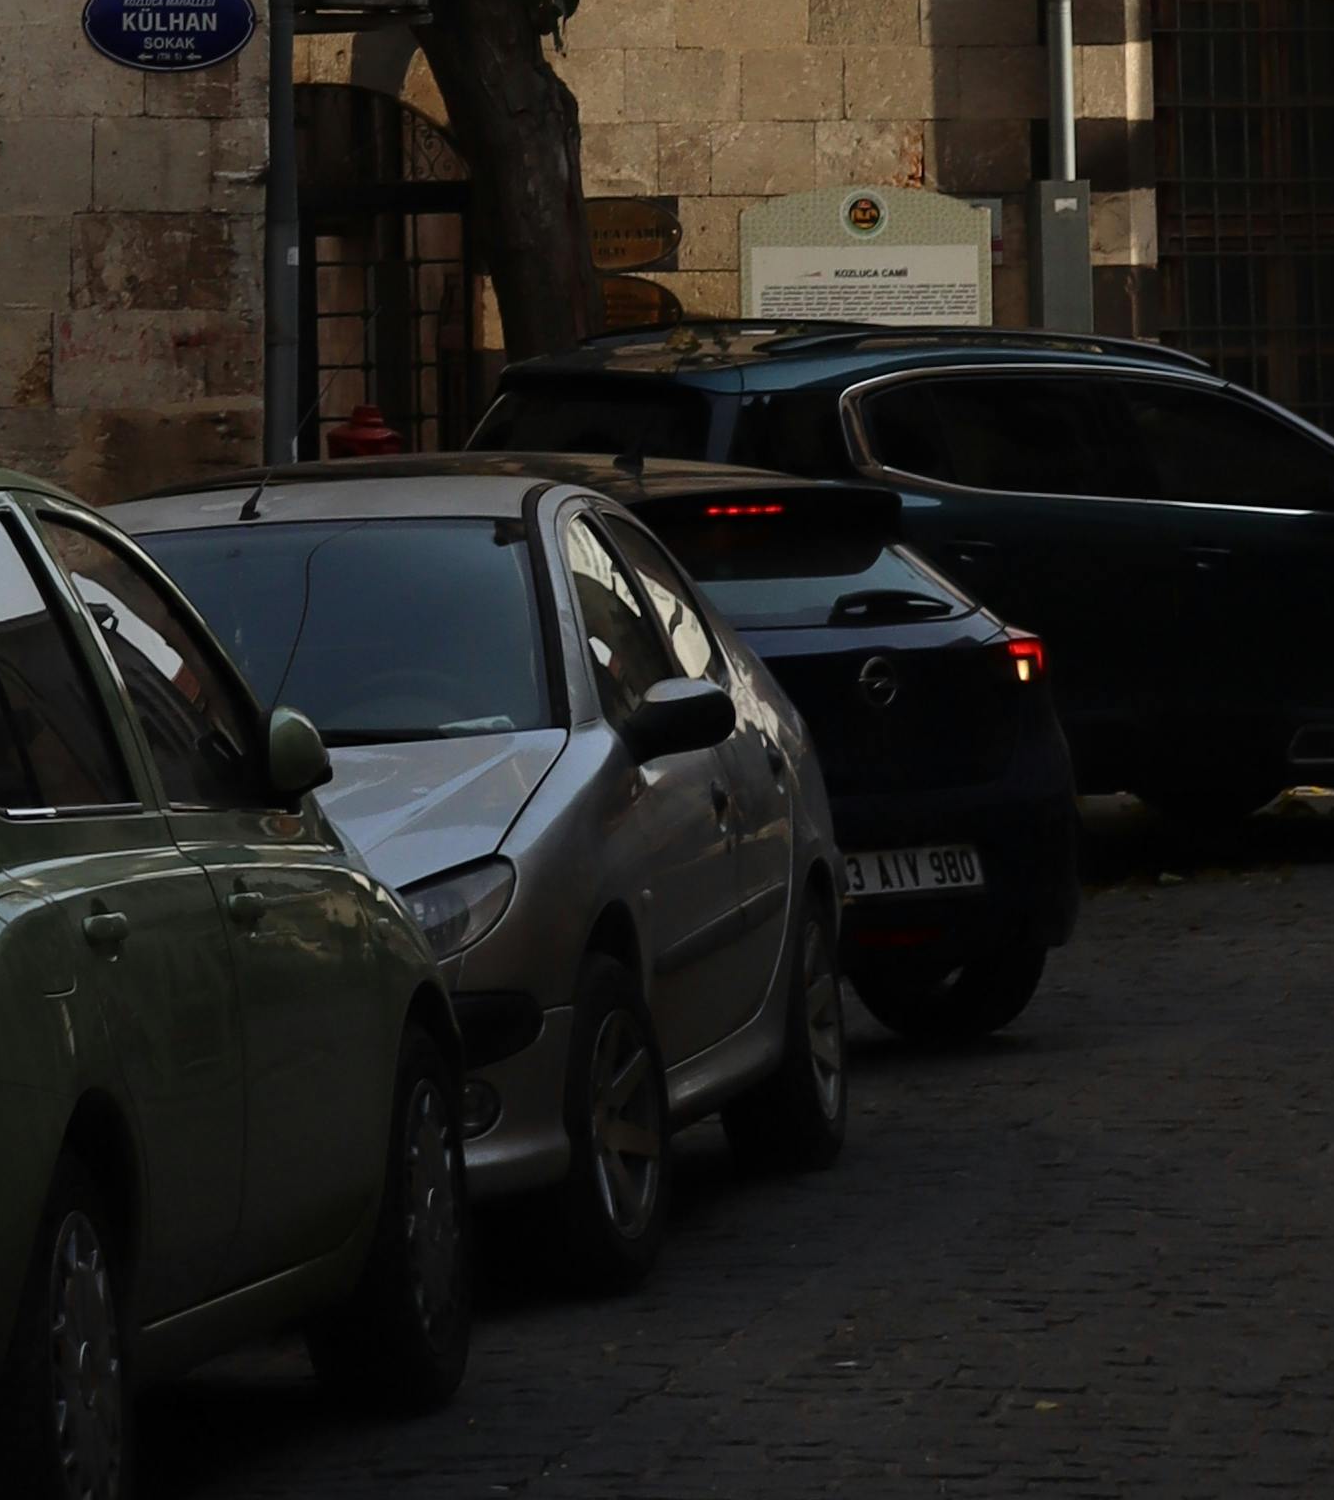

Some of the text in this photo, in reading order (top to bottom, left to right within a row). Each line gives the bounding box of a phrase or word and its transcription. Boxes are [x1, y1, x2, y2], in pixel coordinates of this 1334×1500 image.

[122, 8, 218, 32] KÜLHAN
[143, 37, 196, 49] SOKAK
[834, 268, 878, 278] KOZLUCA
[844, 856, 865, 891] 3
[929, 850, 976, 884] 980
